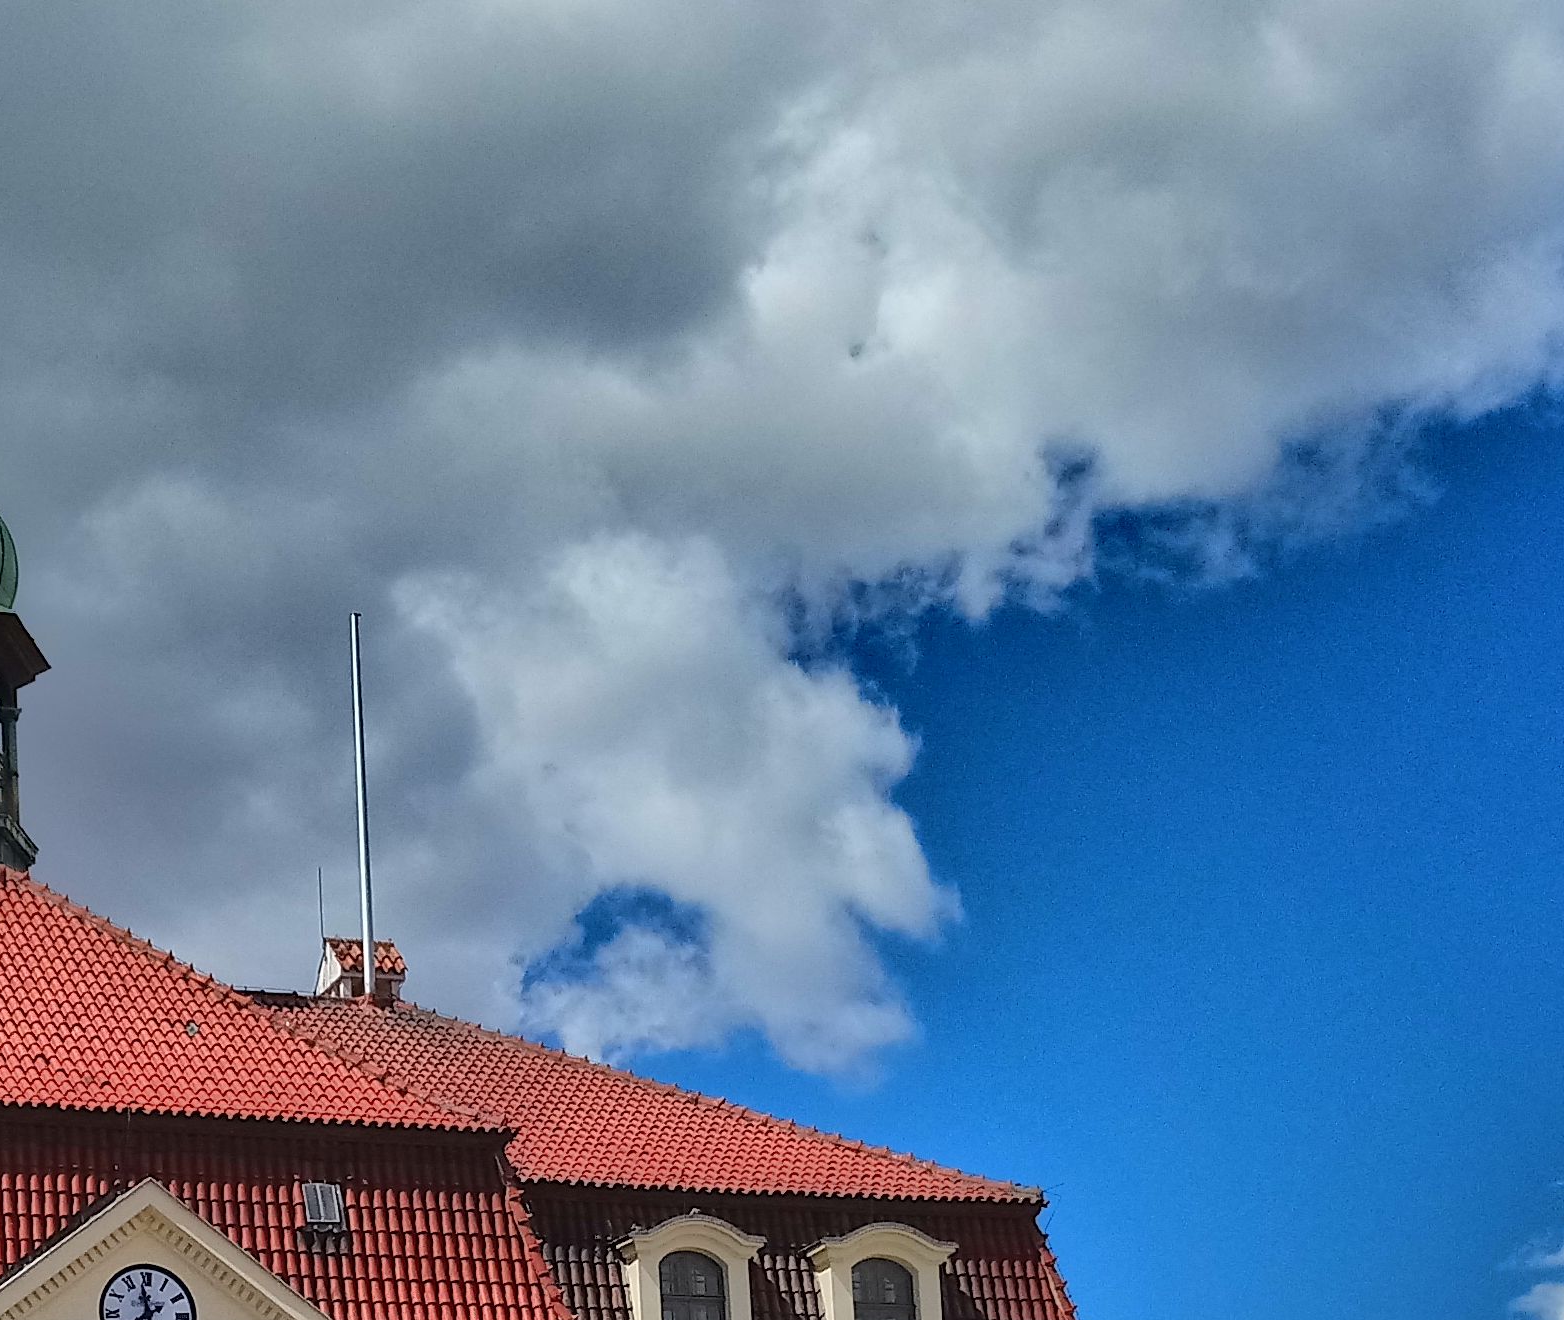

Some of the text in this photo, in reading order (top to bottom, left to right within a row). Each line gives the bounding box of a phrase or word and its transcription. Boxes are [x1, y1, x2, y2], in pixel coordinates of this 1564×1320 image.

[159, 1278, 169, 1292] I
[108, 1289, 125, 1303] X
[105, 1308, 120, 1319] IX
